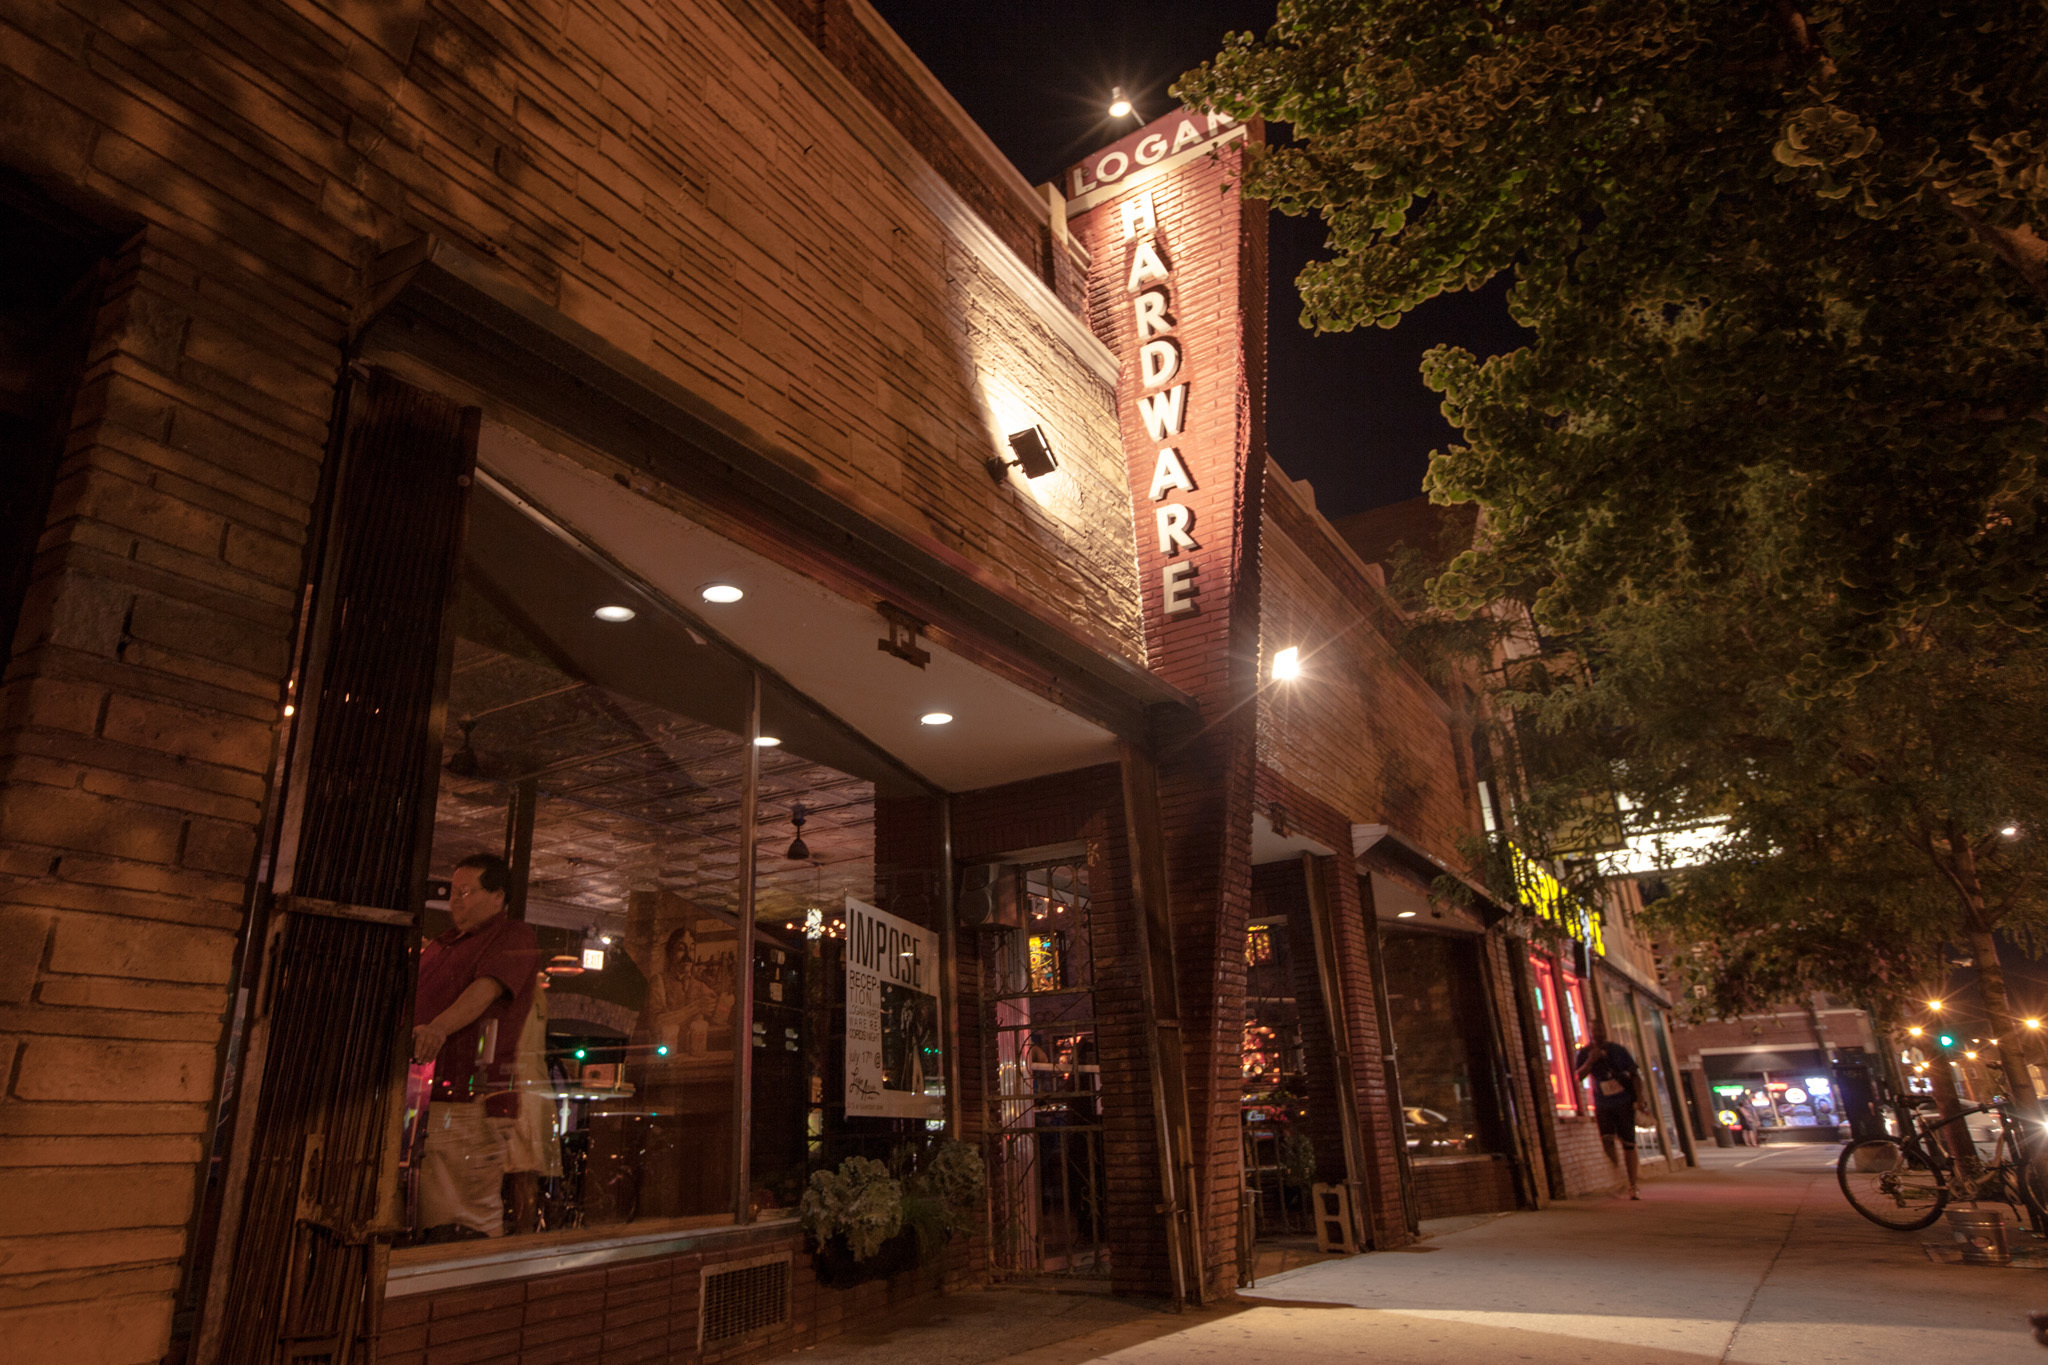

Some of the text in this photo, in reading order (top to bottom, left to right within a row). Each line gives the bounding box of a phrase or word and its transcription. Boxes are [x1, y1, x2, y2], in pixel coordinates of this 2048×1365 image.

[1119, 190, 1200, 616] HARDWARE
[585, 952, 601, 967] EXIT
[850, 908, 922, 989] IMPOSE
[849, 969, 880, 992] RECEP-
[874, 1052, 881, 1069] @
